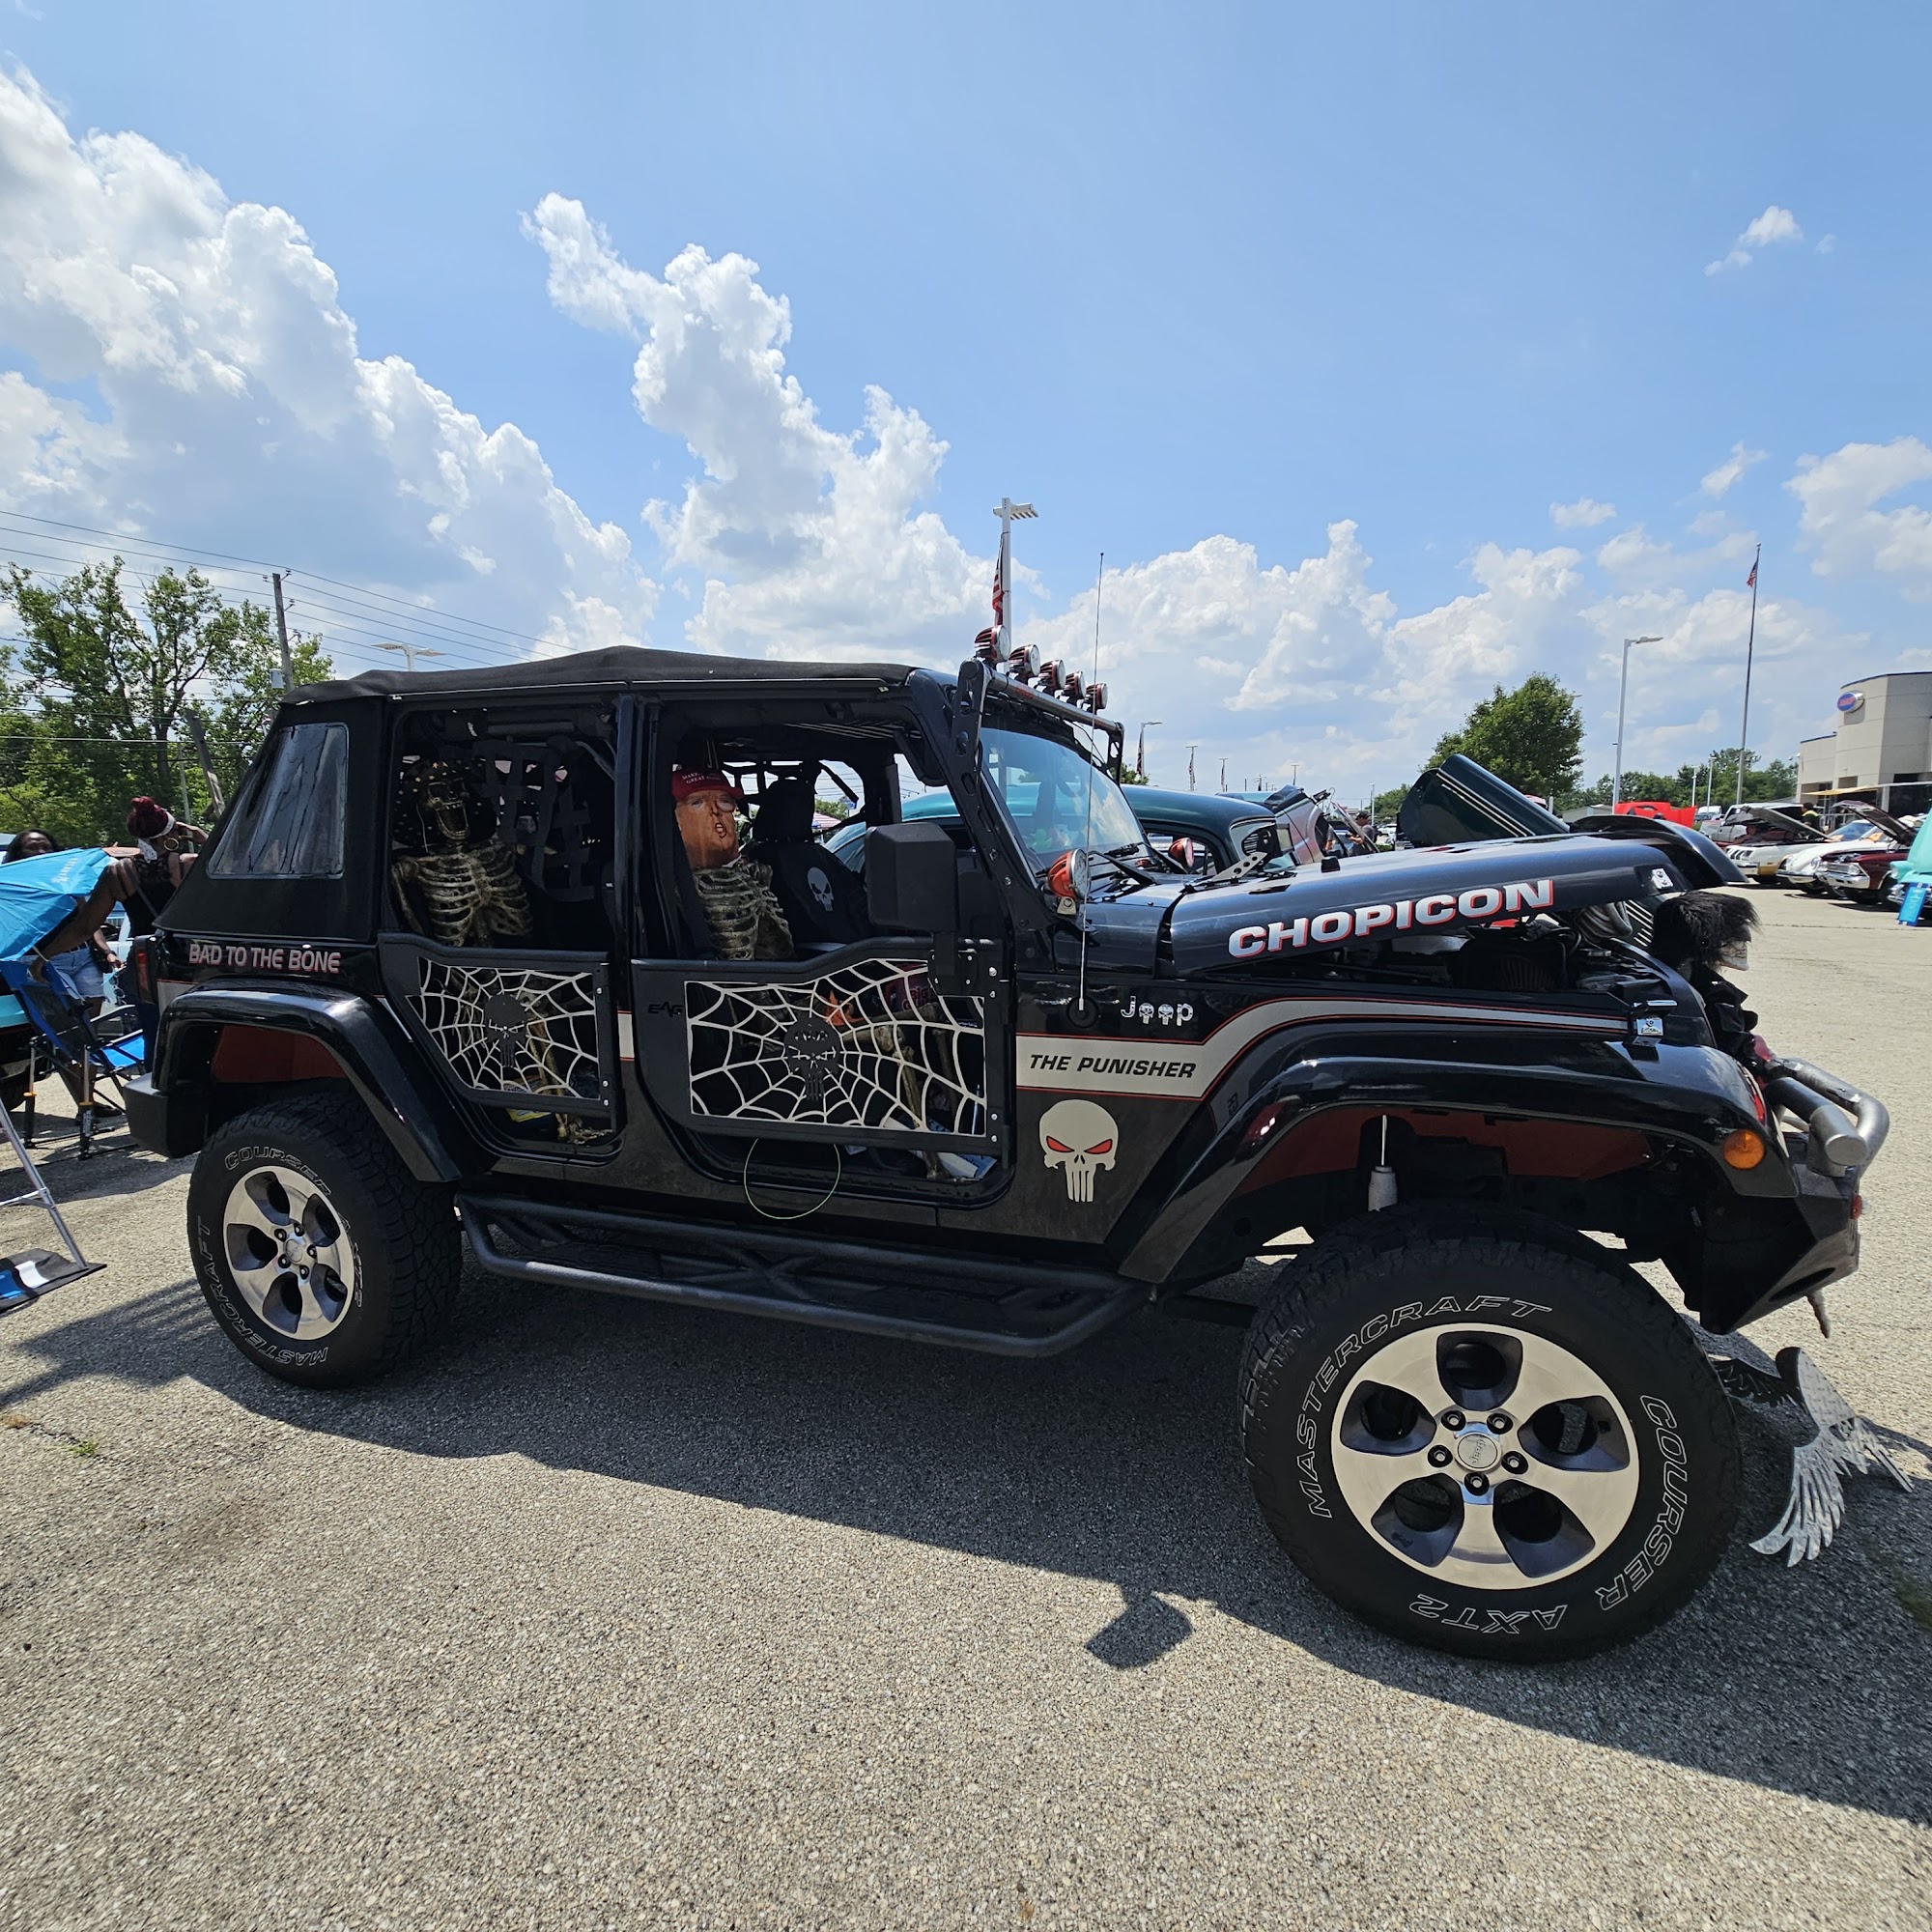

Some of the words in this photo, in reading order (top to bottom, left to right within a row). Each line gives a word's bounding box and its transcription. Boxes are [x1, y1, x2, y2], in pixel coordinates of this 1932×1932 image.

[1228, 879, 1553, 958] CHOPICON
[188, 944, 222, 965] BAD
[226, 946, 247, 966] TO
[250, 948, 284, 970] THE
[288, 950, 341, 974] BONE
[1030, 1054, 1071, 1070] THE
[1077, 1057, 1196, 1078] PUNISHER
[224, 1146, 332, 1197] COURSER
[197, 1215, 328, 1366] MASTERCRAFT
[1296, 1295, 1552, 1518] MASTERCRAFT
[1595, 1395, 1688, 1610] COURSER
[1408, 1594, 1568, 1634] AXT2
